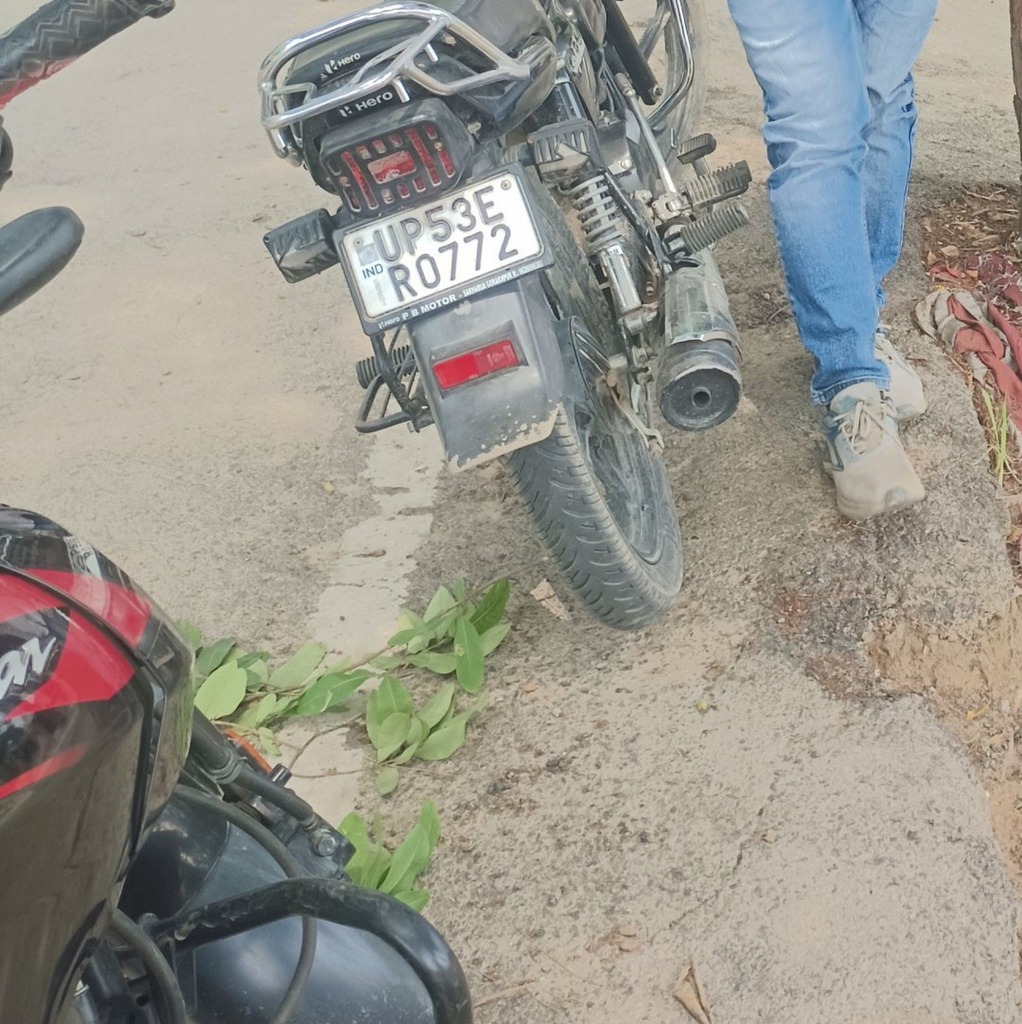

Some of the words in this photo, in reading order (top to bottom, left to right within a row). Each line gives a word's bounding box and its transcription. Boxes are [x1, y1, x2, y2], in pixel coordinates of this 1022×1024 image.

[337, 52, 361, 67] Hero
[355, 91, 393, 111] Hero
[373, 185, 504, 262] UP53E
[362, 263, 384, 279] IND
[387, 223, 519, 302] R0772
[411, 309, 419, 318] B
[420, 293, 458, 314] MOTOR
